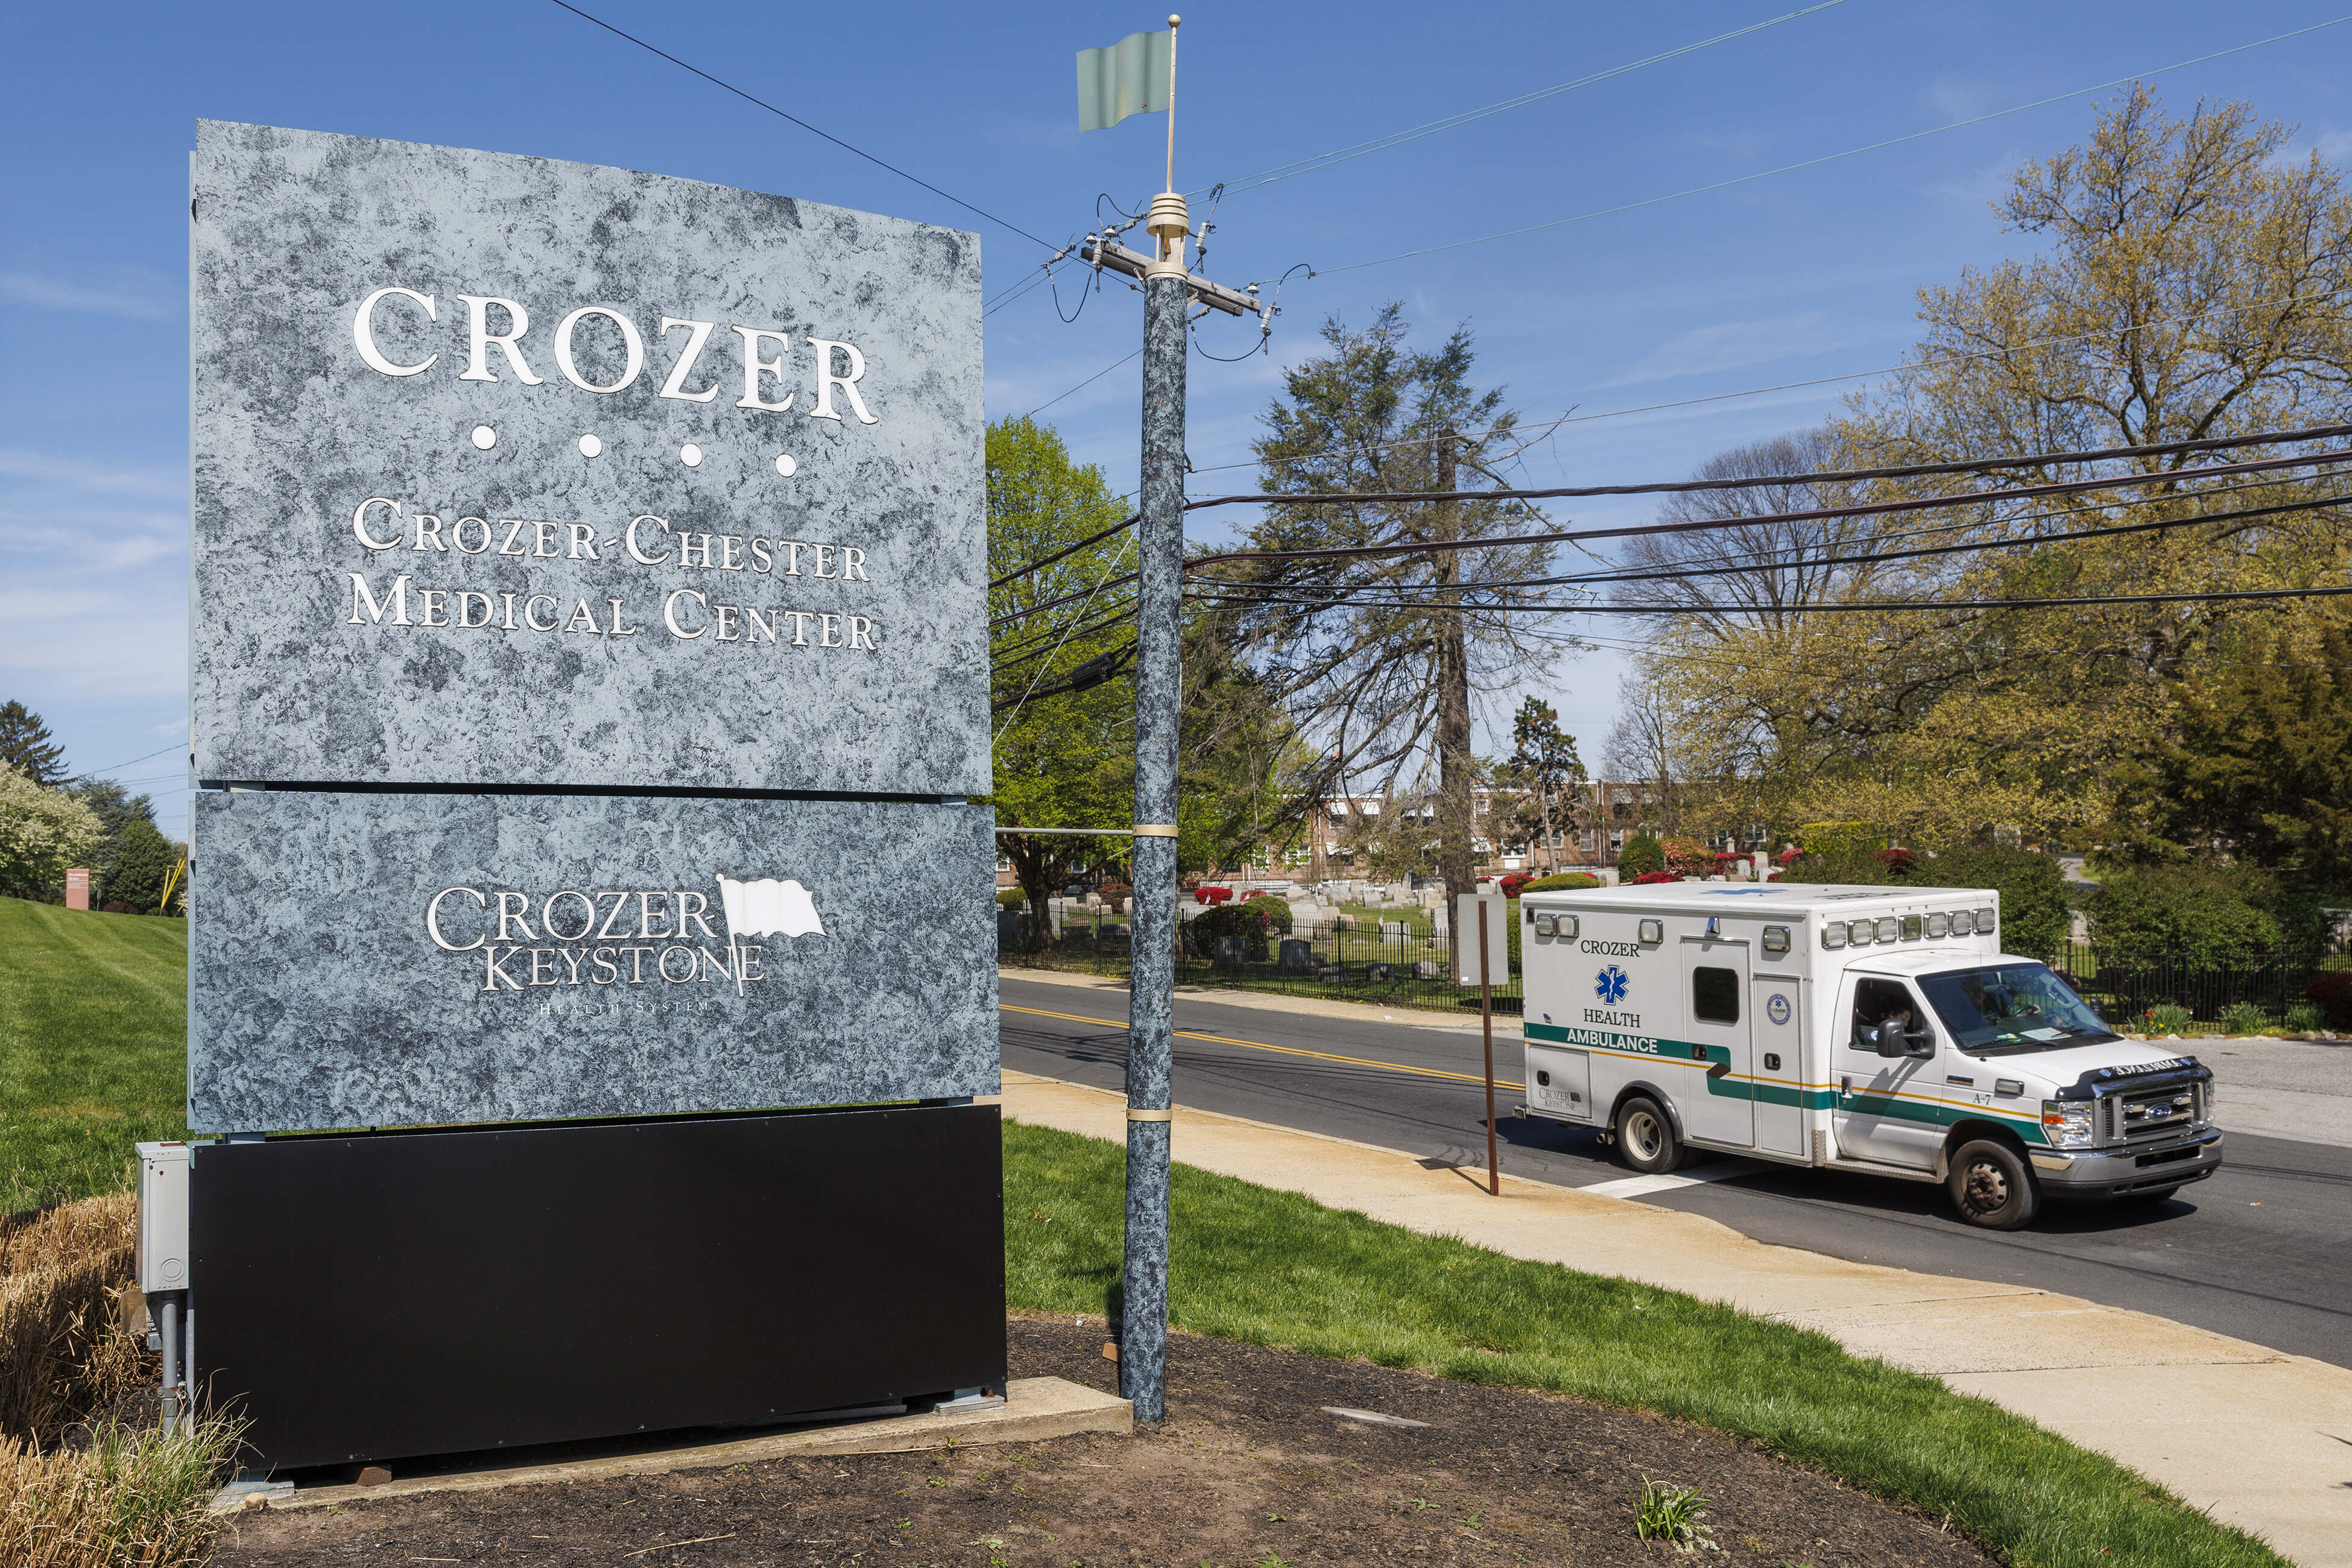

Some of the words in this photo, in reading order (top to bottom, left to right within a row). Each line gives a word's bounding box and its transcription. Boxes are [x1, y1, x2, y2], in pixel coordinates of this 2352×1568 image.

[352, 286, 878, 425] CROZER
[352, 497, 870, 582] CROZER-CHESTER
[347, 573, 636, 636] MEDICAL
[663, 589, 877, 651] CENTER
[1581, 940, 1640, 957] CROZER
[482, 944, 765, 991] KEYSTONE
[540, 1003, 619, 1015] HEALTH
[636, 1001, 709, 1013] SYSTEM
[1584, 1008, 1640, 1028] HEALTH
[1567, 1028, 1658, 1054] AMBULANCE
[1539, 1087, 1569, 1101] CROZER
[1973, 1093, 1991, 1105] A-7
